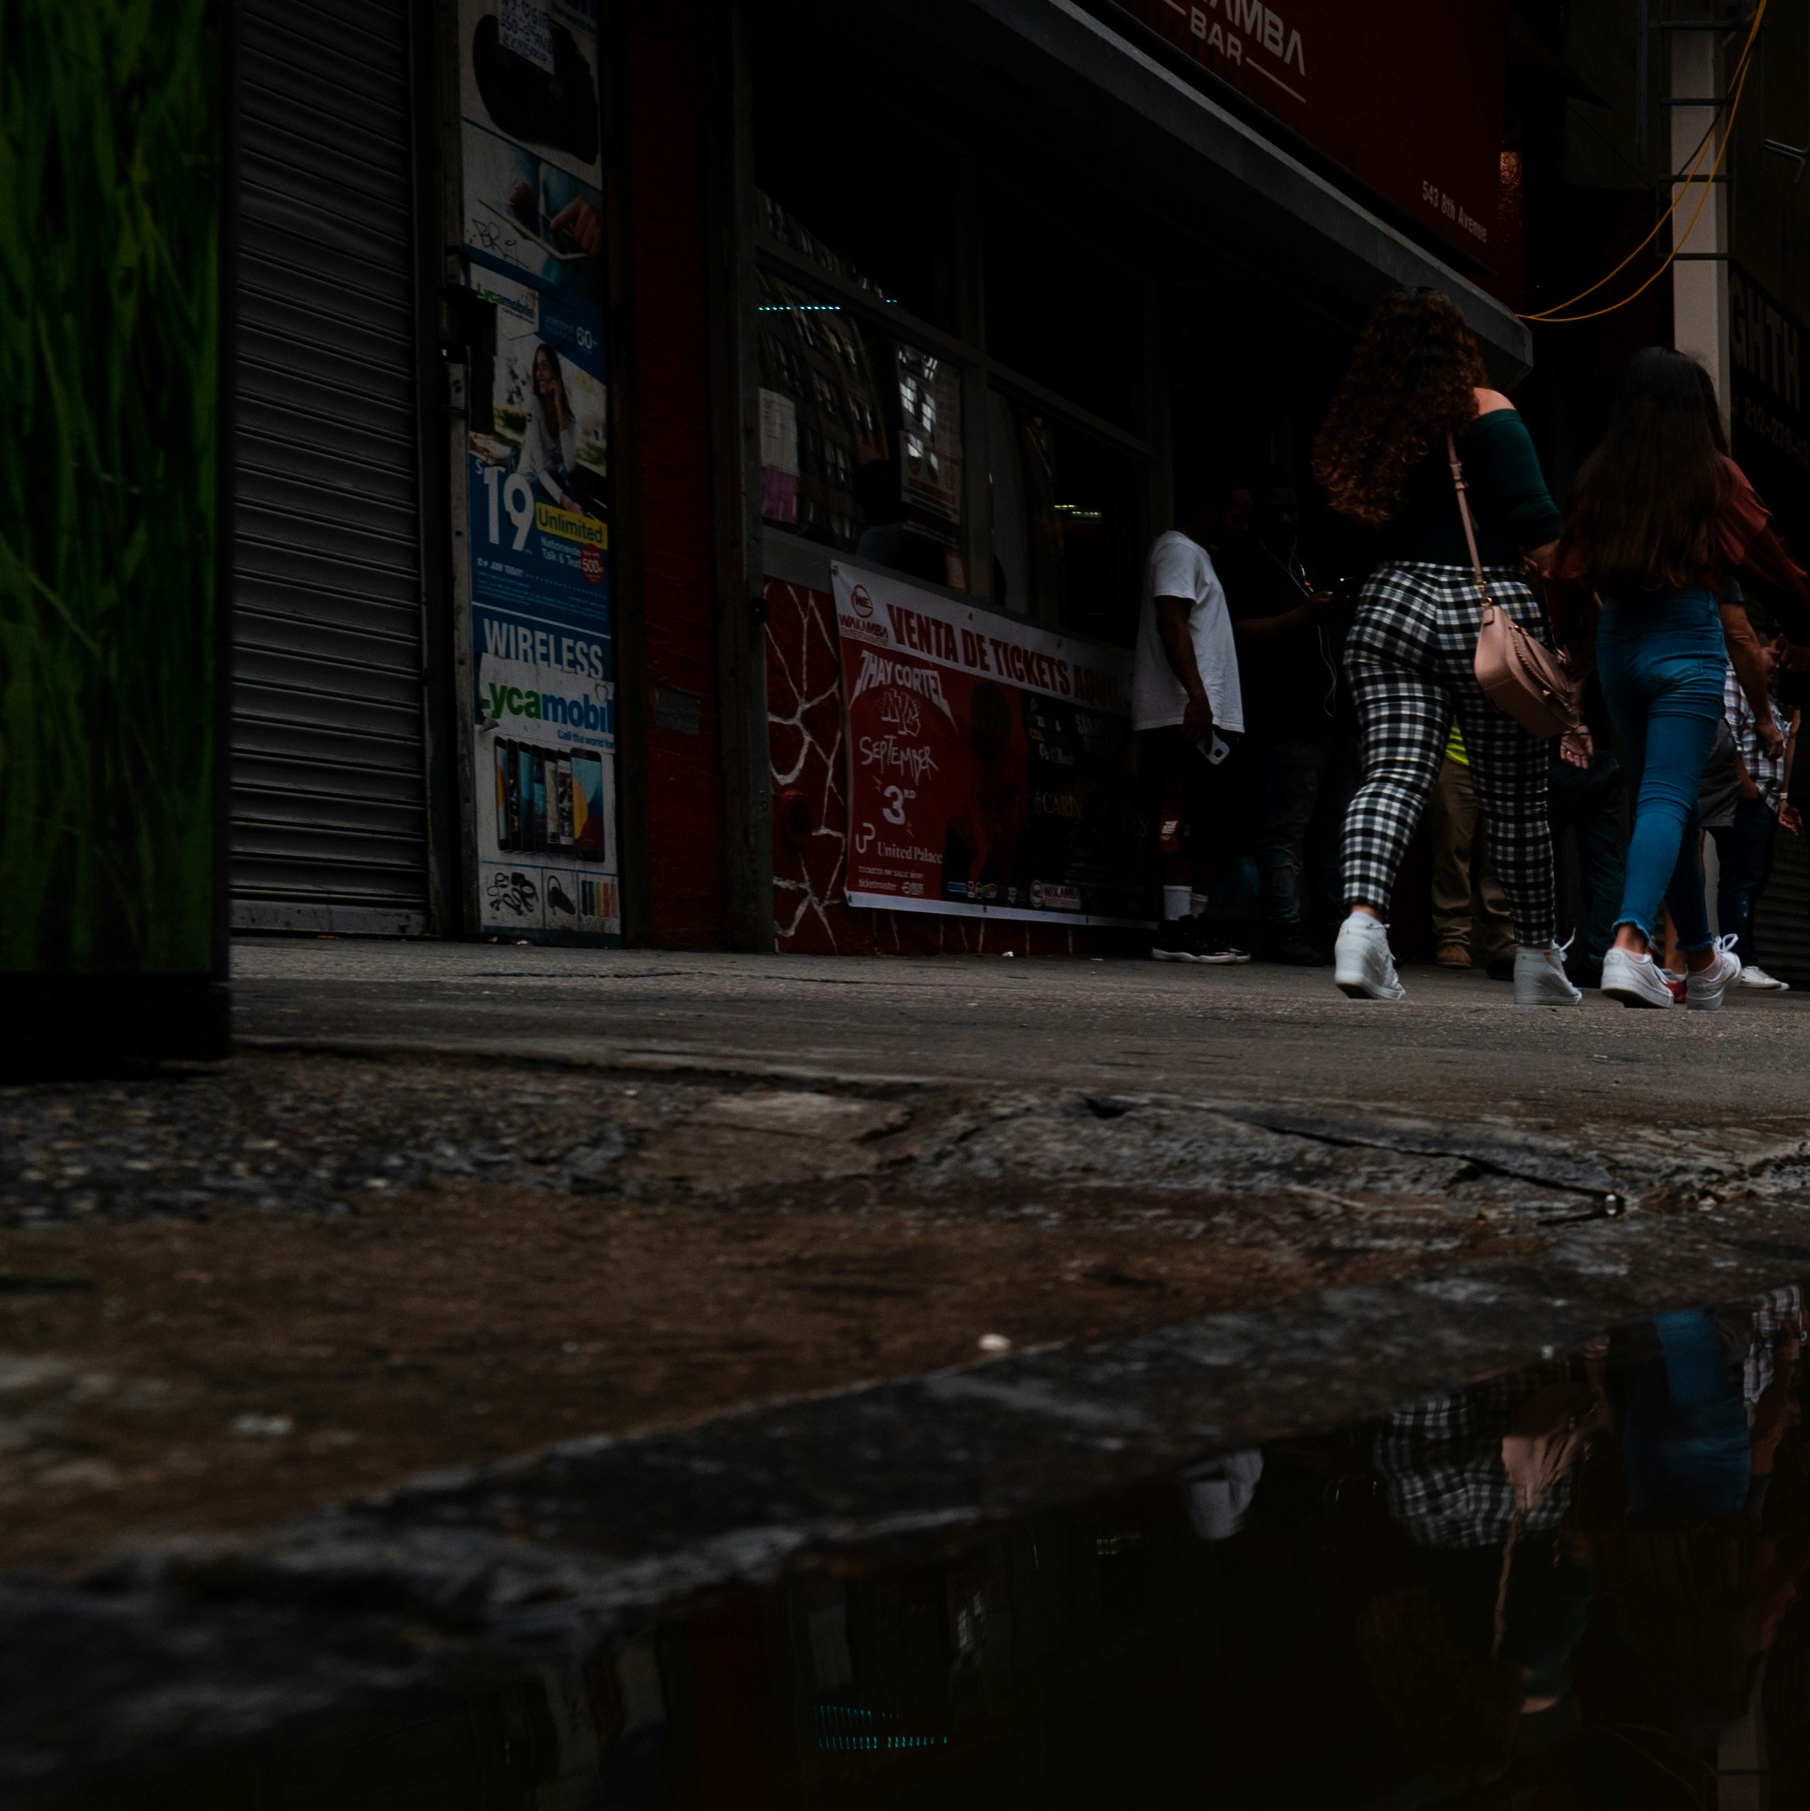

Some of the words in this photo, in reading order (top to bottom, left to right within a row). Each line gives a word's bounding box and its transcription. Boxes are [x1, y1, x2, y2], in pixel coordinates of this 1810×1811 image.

[1189, 5, 1243, 68] BAR
[1422, 179, 1439, 210] 543
[538, 505, 602, 544] Unlimited
[482, 617, 604, 681] WIRELESS
[887, 603, 959, 664] VENTA
[960, 629, 991, 673] DE
[990, 638, 1071, 696] TICKETS
[859, 734, 940, 787] SEPTEMBER
[876, 841, 913, 861] United
[913, 846, 944, 865] Palace
